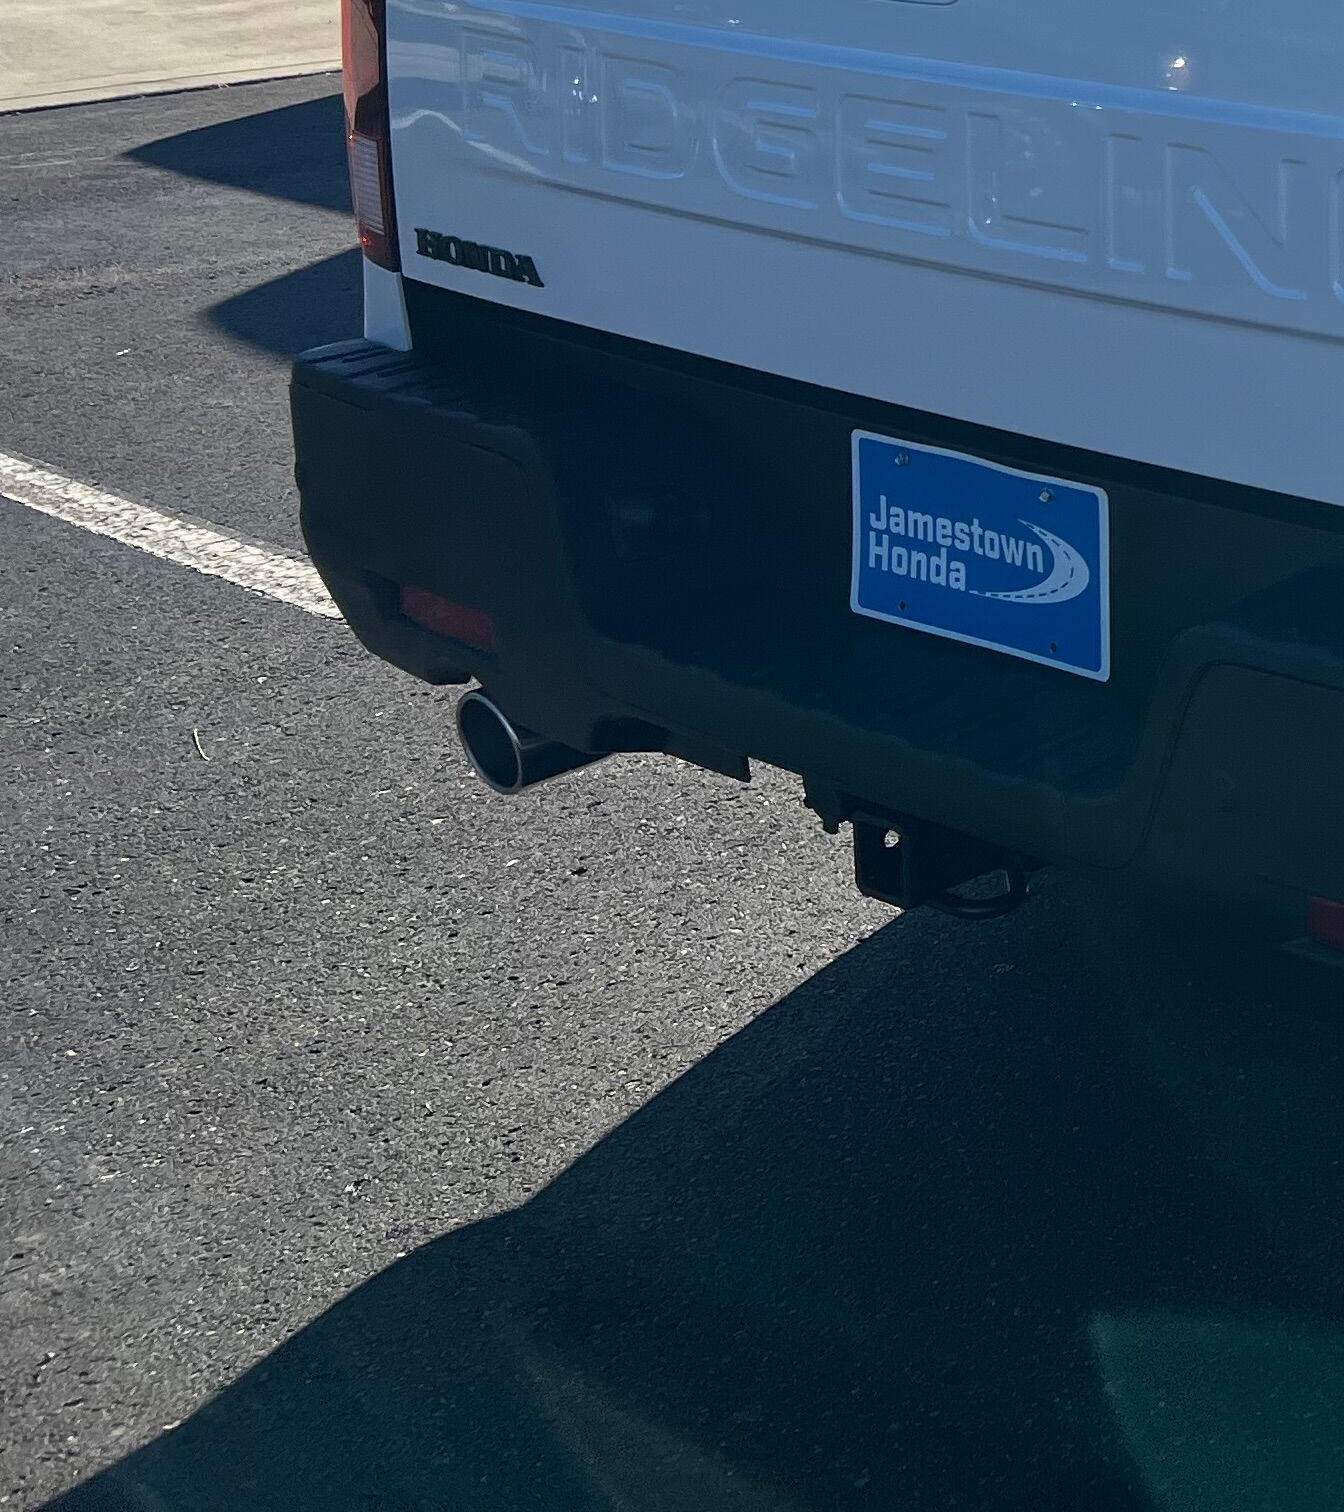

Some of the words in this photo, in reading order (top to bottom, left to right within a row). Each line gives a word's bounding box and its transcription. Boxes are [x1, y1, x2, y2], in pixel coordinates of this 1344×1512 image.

[414, 228, 545, 288] HONDA
[868, 531, 967, 592] Honda
[869, 495, 1045, 574] Jamestown
